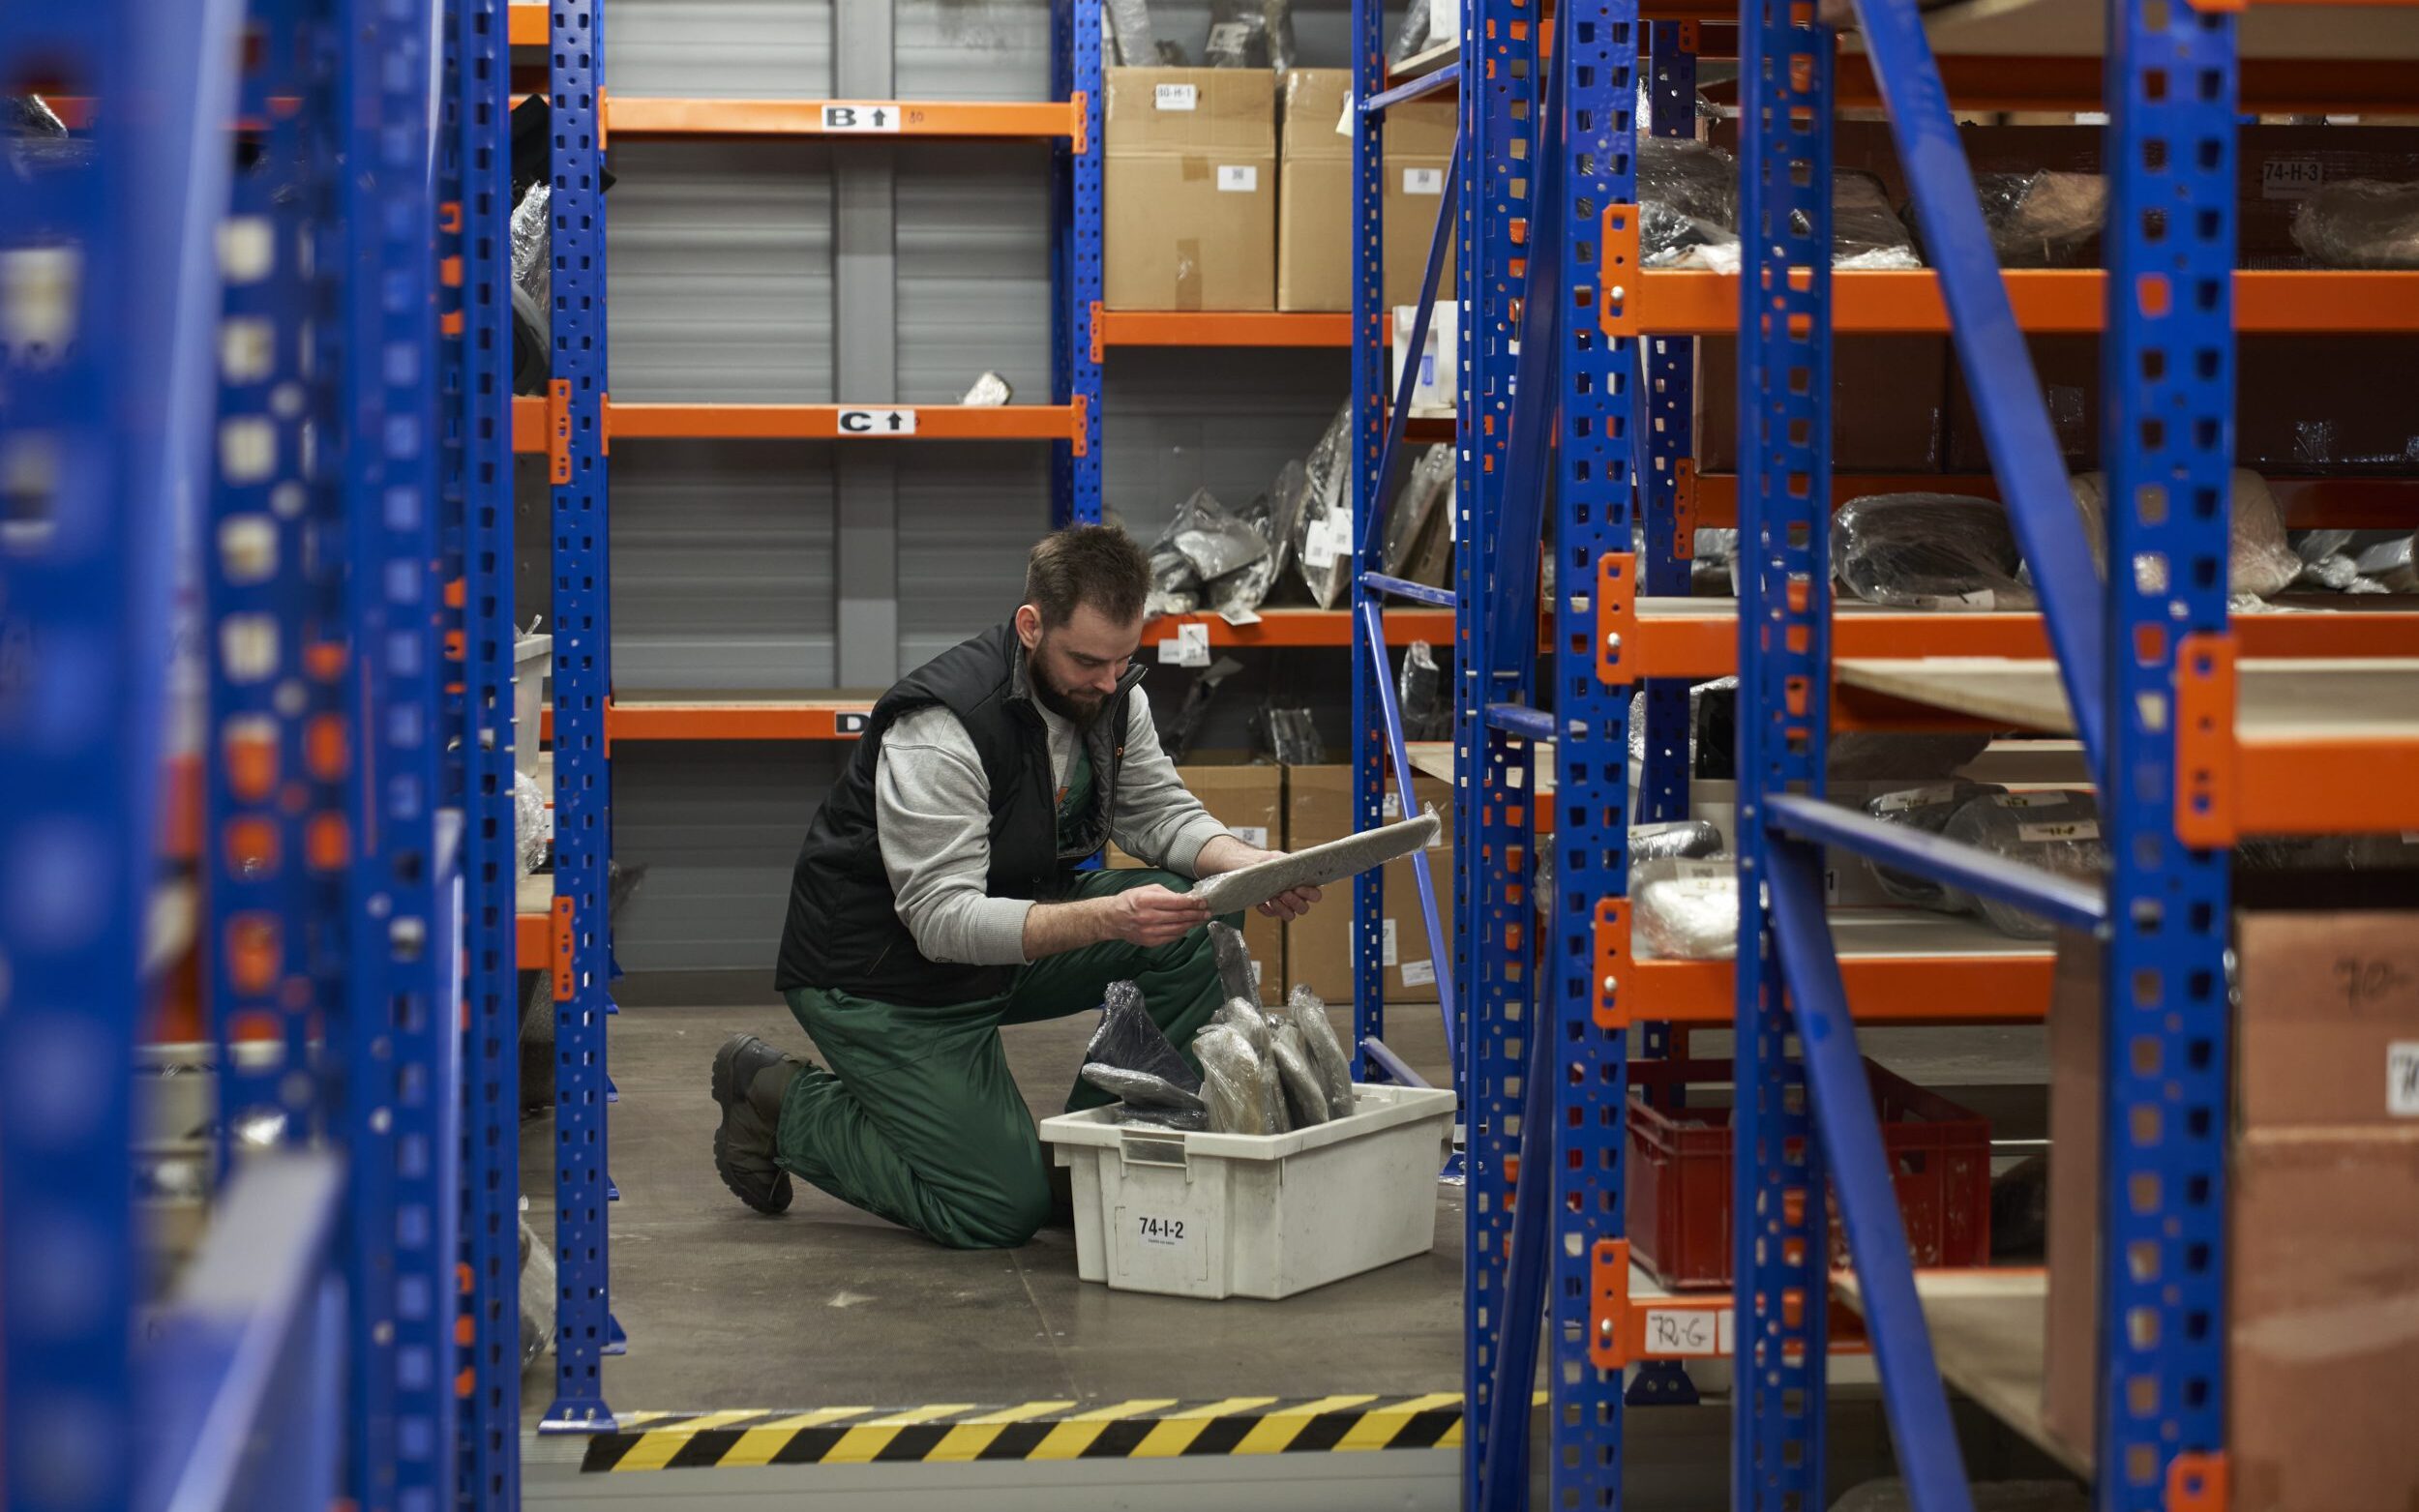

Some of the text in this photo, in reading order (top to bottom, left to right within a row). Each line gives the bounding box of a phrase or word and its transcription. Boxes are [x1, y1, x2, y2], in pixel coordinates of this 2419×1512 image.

[826, 107, 856, 127] B
[2265, 163, 2318, 181] 74-H-3
[841, 412, 872, 432] C
[836, 714, 870, 732] D
[1139, 1217, 1183, 1239] 74-I-2
